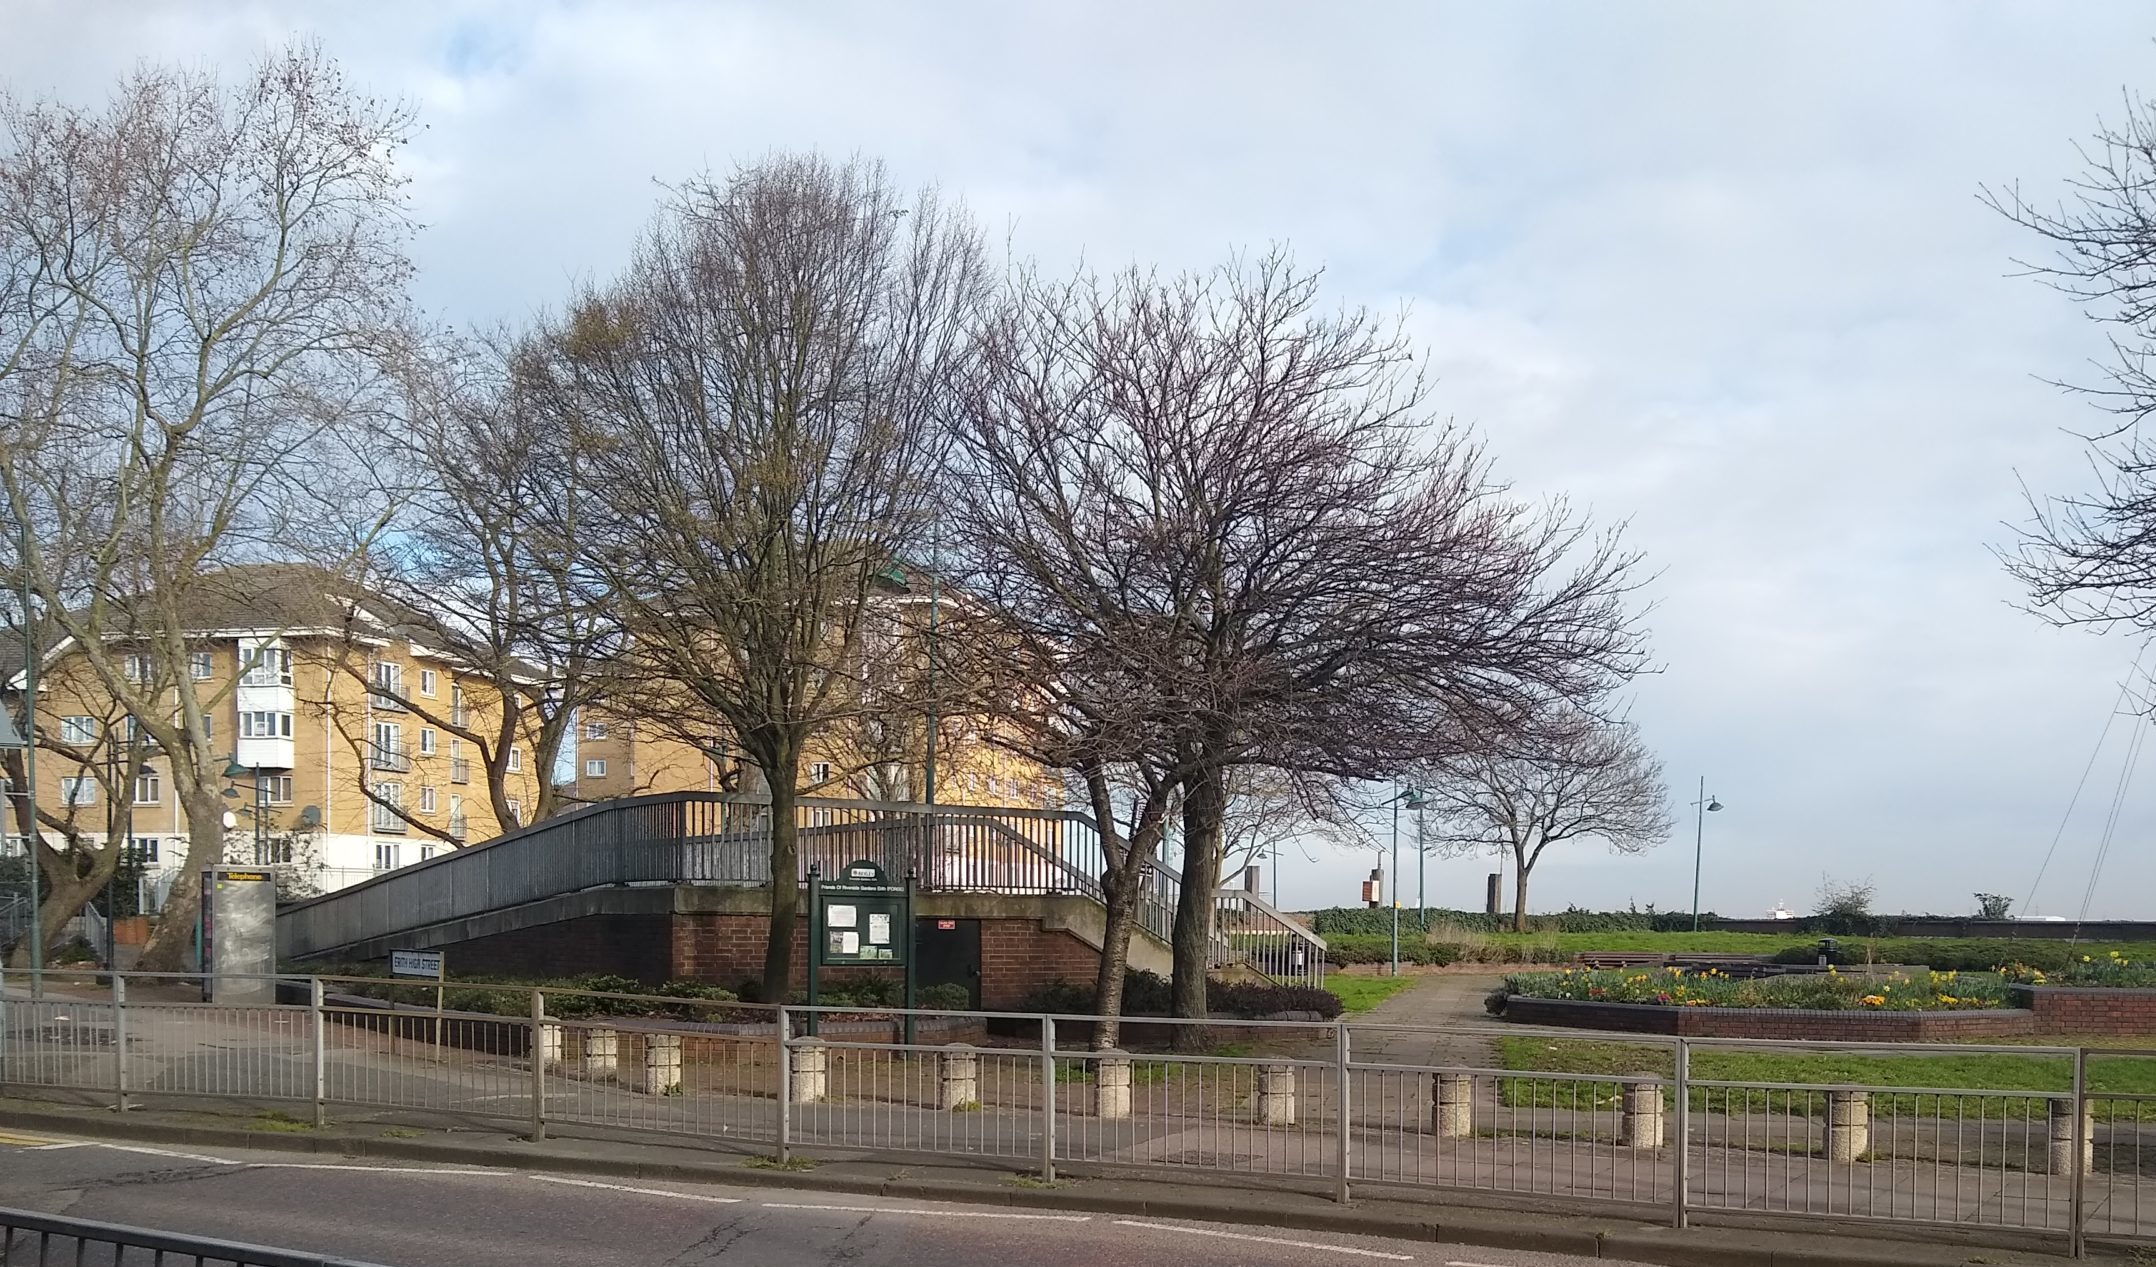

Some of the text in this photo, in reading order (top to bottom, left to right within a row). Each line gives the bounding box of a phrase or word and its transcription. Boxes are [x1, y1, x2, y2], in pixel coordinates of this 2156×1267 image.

[227, 872, 262, 880] Telephone
[394, 957, 440, 970] ERITH HIGH STREET
